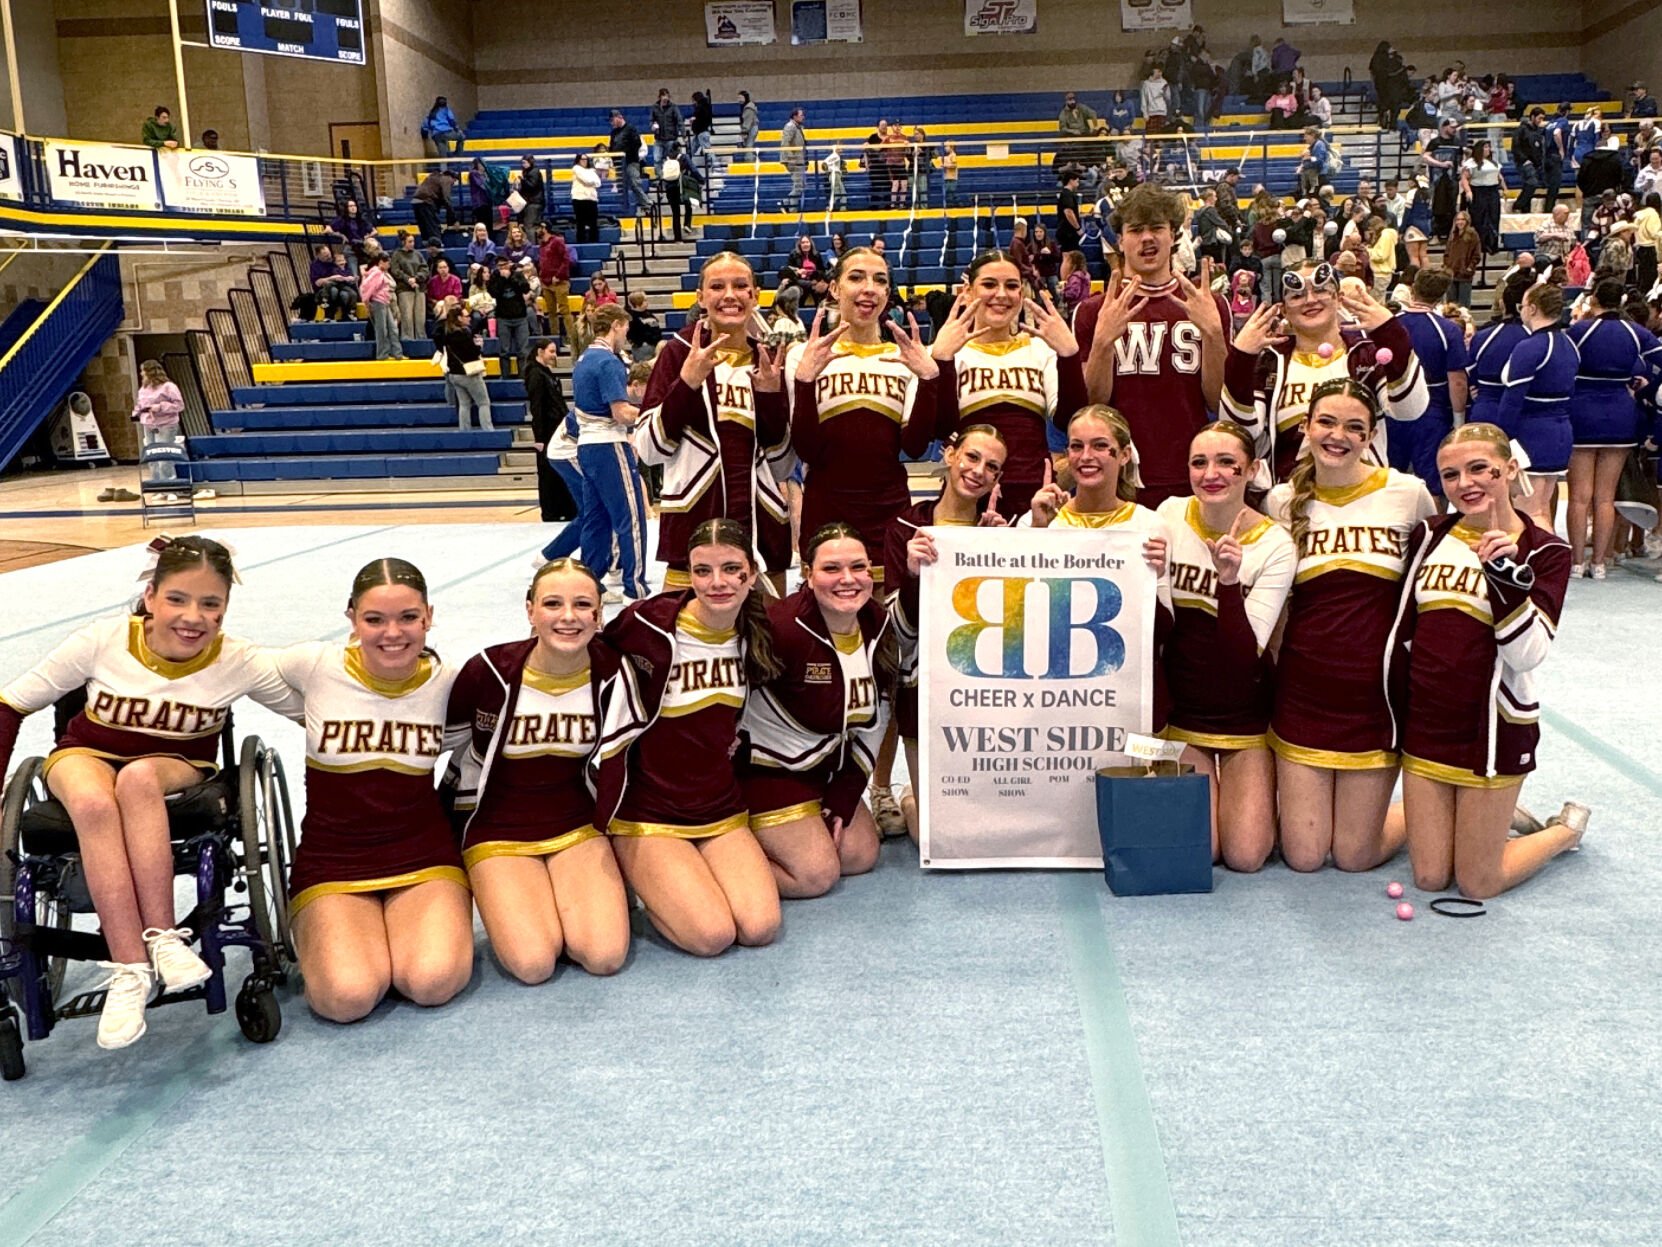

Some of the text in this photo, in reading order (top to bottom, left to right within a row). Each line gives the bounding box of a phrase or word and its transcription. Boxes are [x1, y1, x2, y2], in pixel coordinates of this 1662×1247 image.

[212, 1, 237, 12] FOULS
[261, 8, 314, 23] PLAYER FOUL
[336, 18, 359, 29] FOULS
[215, 35, 240, 46] SCORE
[277, 43, 304, 53] MATCH
[338, 51, 361, 60] SCORE
[56, 149, 148, 182] Haven
[1114, 321, 1202, 376] WS
[817, 372, 905, 405] PIRATES
[955, 552, 1125, 570] Battle at the Border
[949, 688, 1117, 708] CHEER x DANCE
[318, 720, 443, 756] PIRATES
[941, 726, 1125, 753] WEST SIDE
[972, 755, 1098, 772] HIGH SCHOOL
[1049, 775, 1070, 783] POM
[941, 788, 969, 796] SHOW
[998, 789, 1026, 797] SHOW
